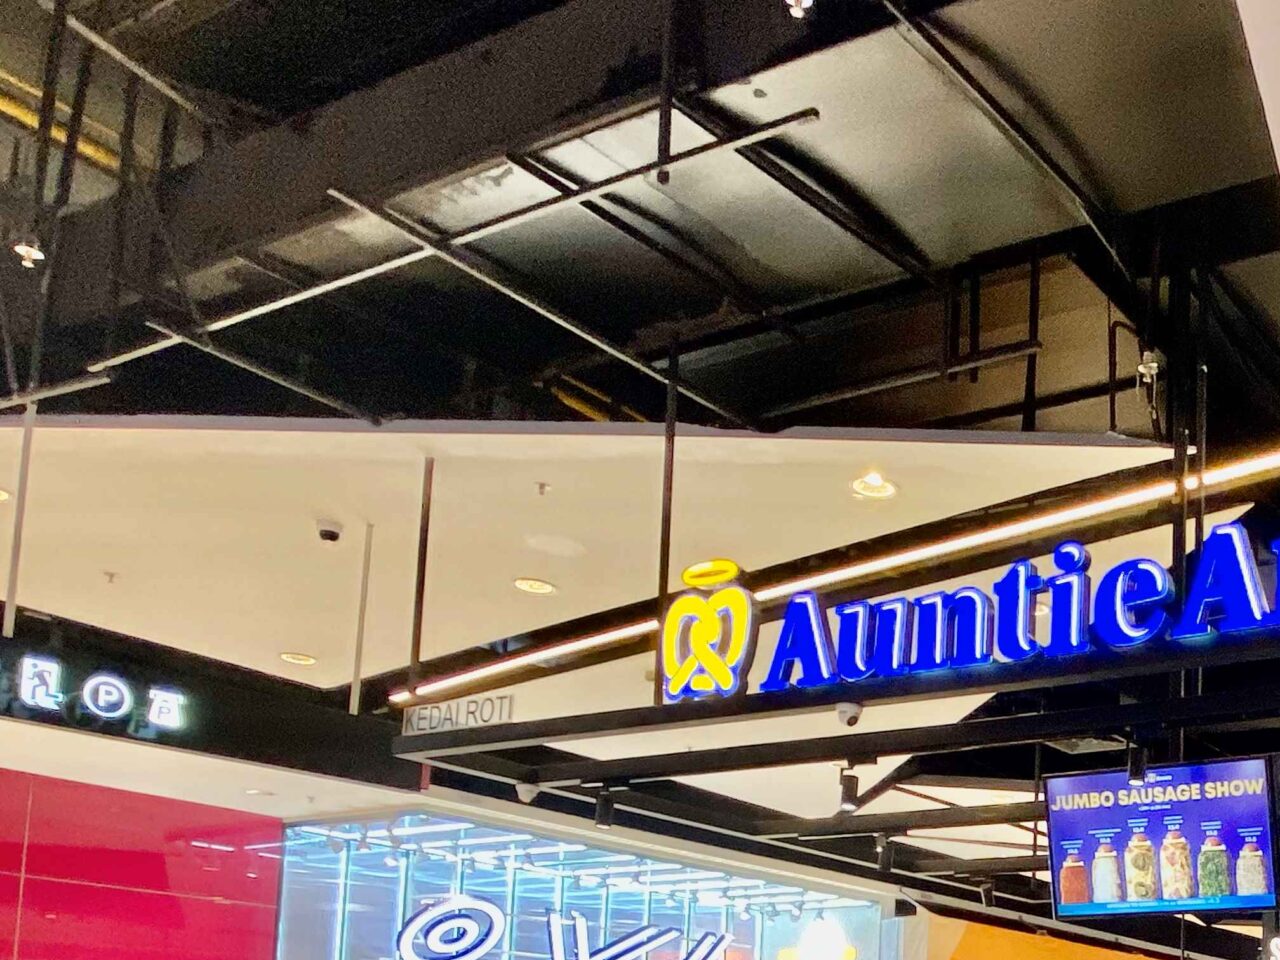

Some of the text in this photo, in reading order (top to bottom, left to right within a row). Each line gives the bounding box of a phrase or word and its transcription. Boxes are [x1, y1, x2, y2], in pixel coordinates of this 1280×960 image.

[403, 695, 514, 733] KEDAI ROTI
[1051, 778, 1265, 812] JUMBO SAUSAGE SHOW
